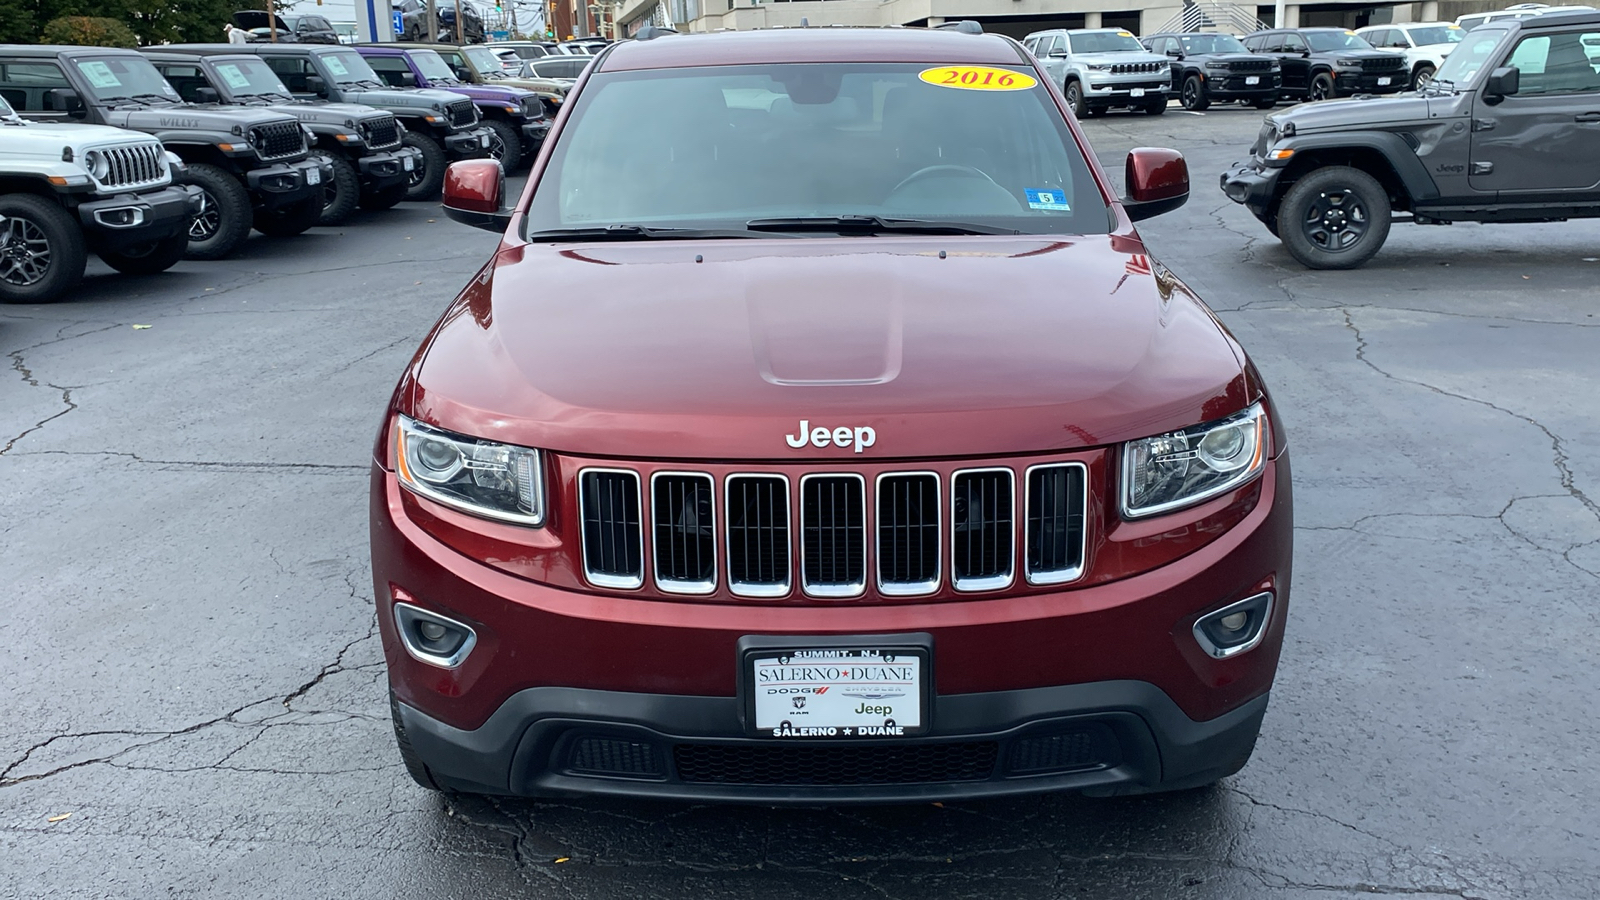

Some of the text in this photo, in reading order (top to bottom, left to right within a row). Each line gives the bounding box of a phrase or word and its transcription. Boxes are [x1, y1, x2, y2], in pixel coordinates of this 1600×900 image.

[941, 70, 1014, 86] 2016
[160, 117, 200, 128] WILLYS
[1436, 164, 1464, 173] Jeep
[1043, 194, 1051, 202] 5
[785, 419, 876, 453] Jeep
[794, 650, 880, 658] SUMMIT, NJ
[759, 667, 914, 682] SALERNO DUANE
[767, 687, 821, 695] DODGE
[854, 702, 893, 716] Jeep
[772, 726, 904, 737] SALERNO DUANE
